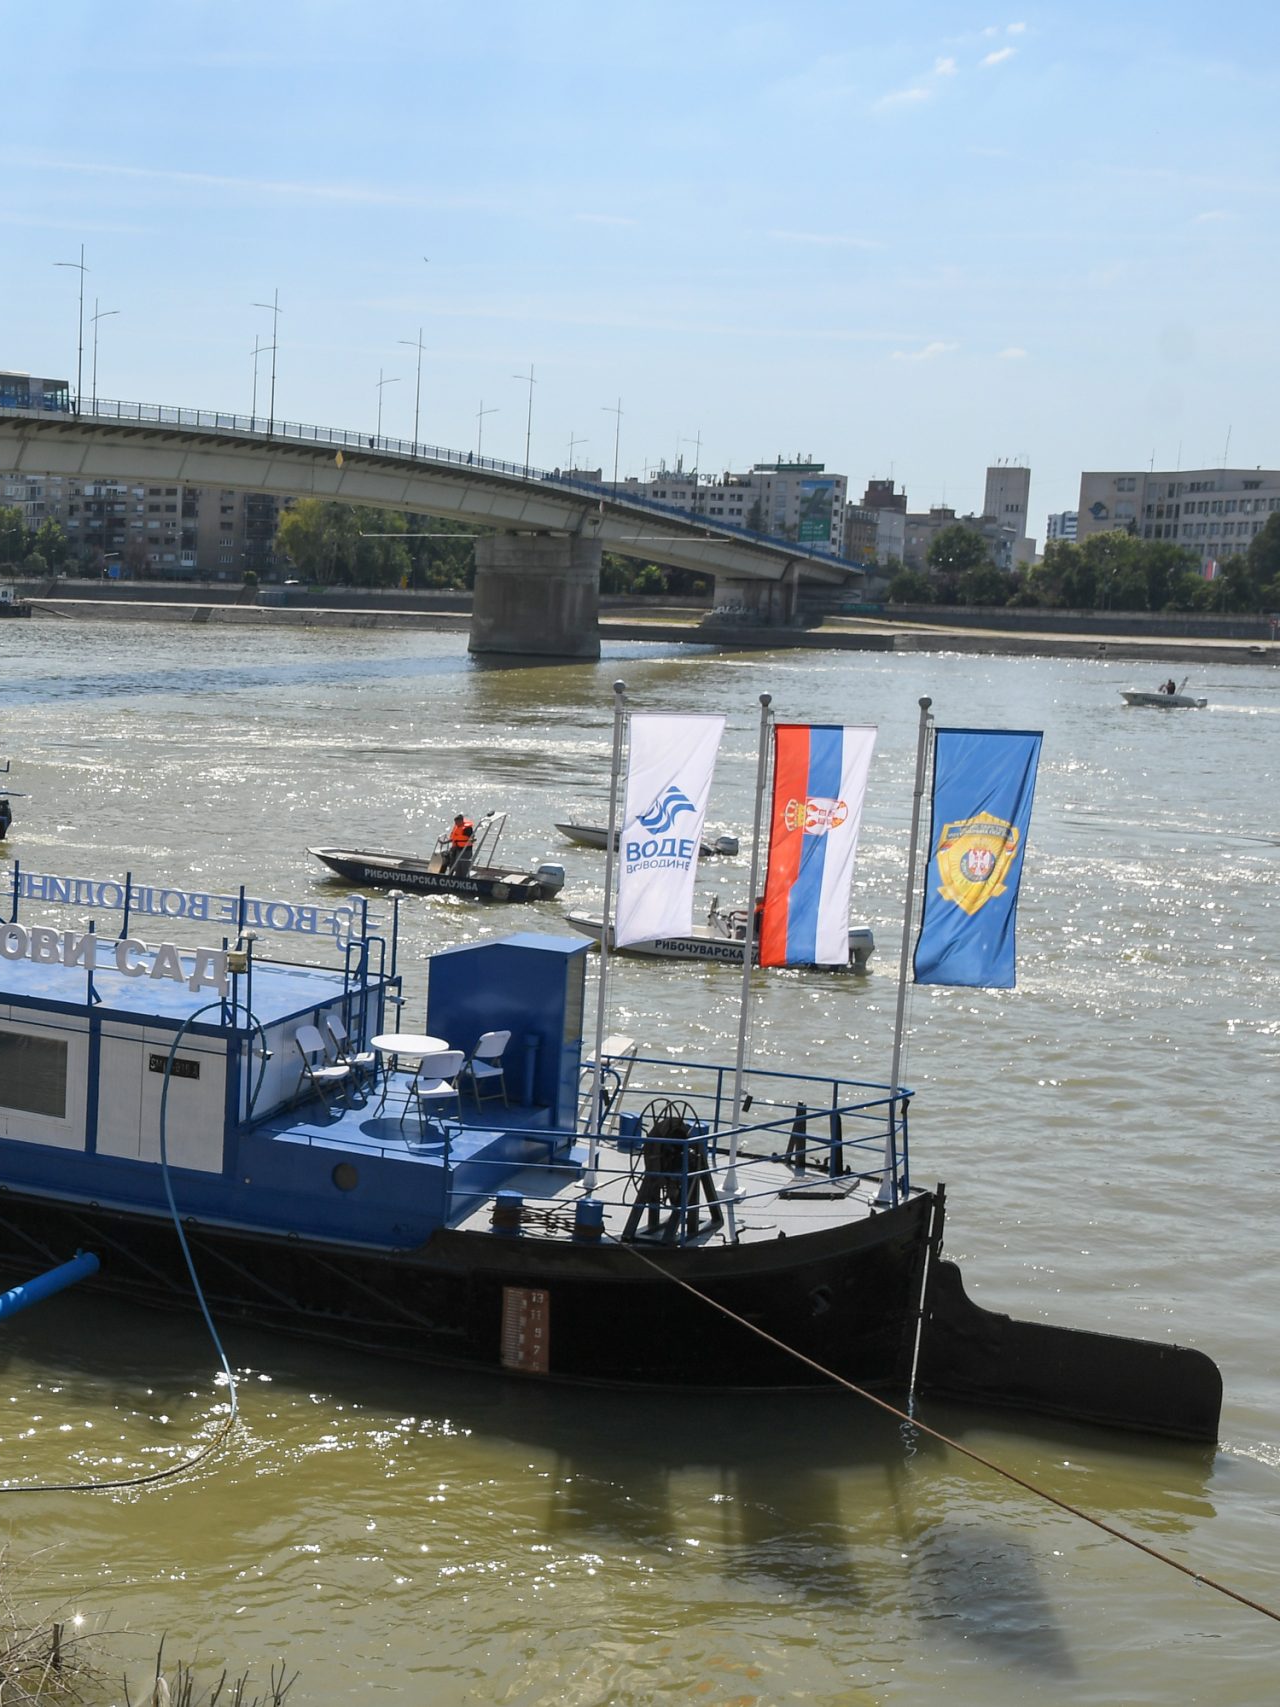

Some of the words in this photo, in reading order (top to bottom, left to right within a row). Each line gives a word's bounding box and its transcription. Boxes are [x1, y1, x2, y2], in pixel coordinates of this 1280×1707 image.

[626, 838, 695, 863] ВОДЕ
[364, 868, 437, 886] РИБОЧУВАРСКА
[439, 878, 479, 892] СЛУЖБА
[655, 939, 744, 959] РИБОЧУВАРСКА
[118, 938, 231, 998] САД
[533, 1344, 540, 1355] 7
